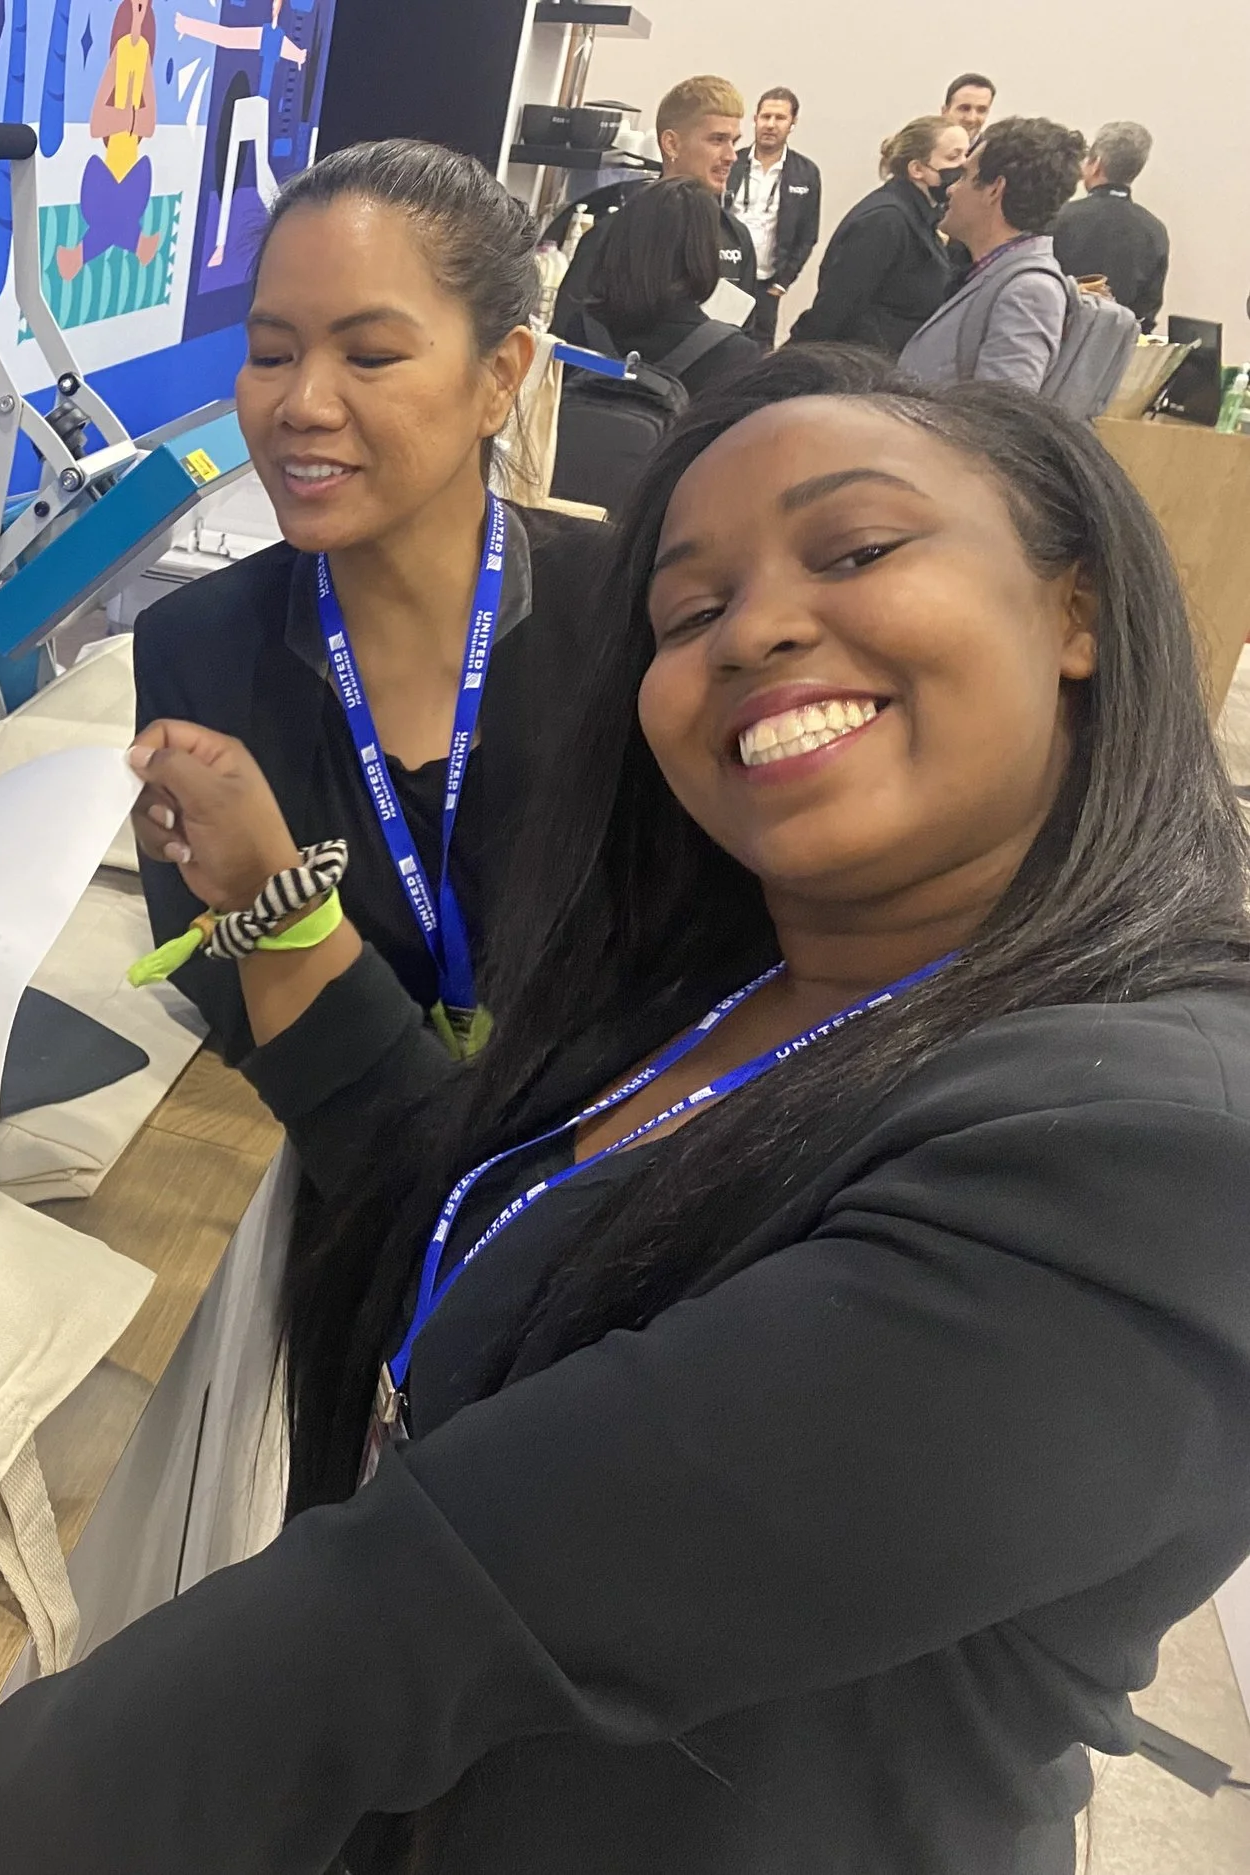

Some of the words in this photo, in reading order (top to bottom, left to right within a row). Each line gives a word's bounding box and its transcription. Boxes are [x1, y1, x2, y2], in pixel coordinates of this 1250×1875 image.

[494, 501, 505, 554] UNITED
[475, 610, 483, 626] FOR
[475, 611, 494, 670] UNITED
[343, 651, 358, 688] BUSINESS
[467, 627, 479, 669] BUSINESS
[333, 653, 356, 708] UNITED
[353, 689, 362, 705] FOR
[375, 762, 391, 801] BUSINESS
[452, 732, 469, 790] UNITED
[366, 764, 391, 821] UNITED
[387, 802, 397, 818] FOR
[406, 874, 434, 932] UNITED
